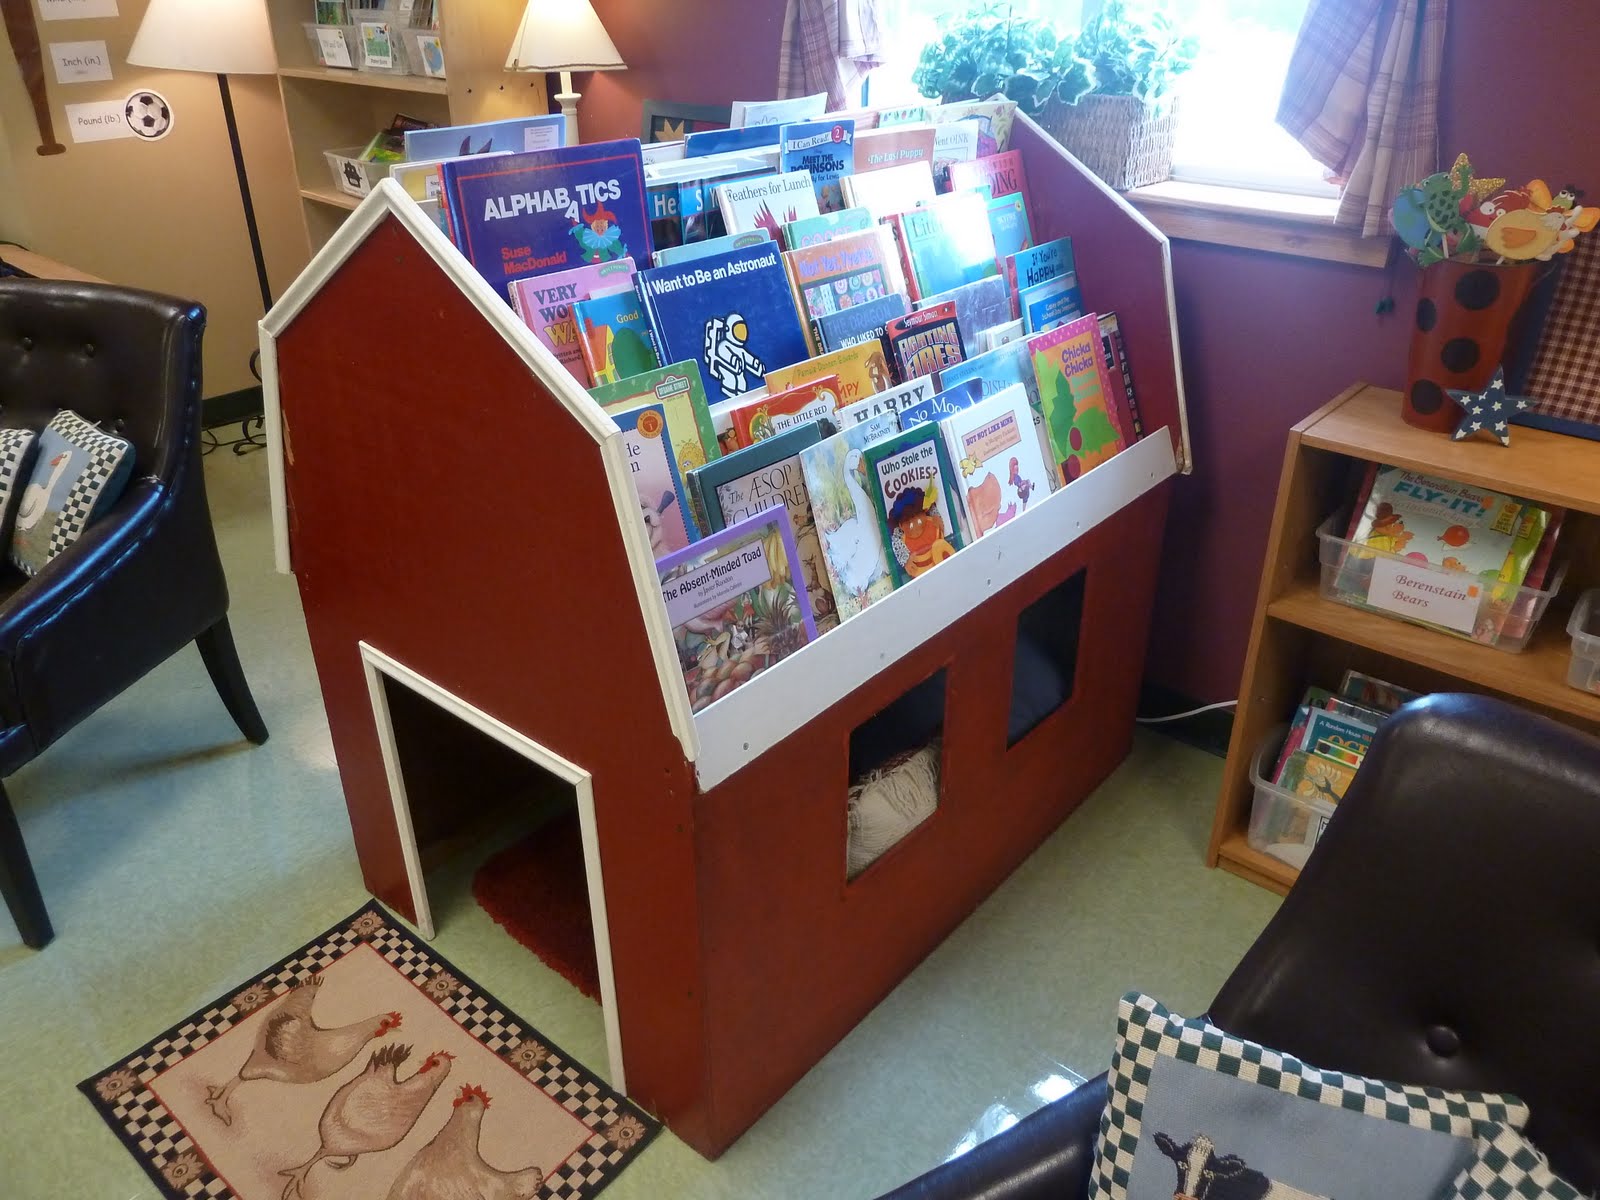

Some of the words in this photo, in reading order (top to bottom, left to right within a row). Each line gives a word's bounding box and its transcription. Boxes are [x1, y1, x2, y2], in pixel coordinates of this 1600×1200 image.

[62, 57, 82, 66] Inch
[78, 116, 102, 126] Pound
[797, 140, 811, 149] Can
[900, 148, 924, 161] Puppy
[802, 155, 821, 165] MEET
[821, 154, 834, 163] THE
[724, 184, 768, 203] Feathers
[768, 182, 782, 194] for
[783, 175, 812, 192] Lunch
[653, 196, 680, 217] He
[501, 245, 532, 261] Suse
[503, 251, 568, 276] MacDonald
[652, 275, 684, 295] Want
[684, 274, 696, 287] to
[695, 270, 712, 284] Be
[713, 267, 728, 280] an
[728, 252, 777, 277] Astronaut
[1026, 263, 1056, 287] Happy
[533, 282, 578, 305] VERY
[616, 310, 639, 324] Good
[904, 313, 923, 328] Seymour
[840, 335, 857, 348] WHO
[857, 330, 875, 344] LIKED
[875, 327, 884, 337] TO
[897, 321, 960, 364] FIGHTING
[904, 345, 963, 380] FIRES
[1061, 341, 1092, 363] Chicka
[1064, 356, 1094, 378] Chicka
[777, 417, 791, 431] THE
[792, 410, 814, 427] LITTLE
[814, 405, 828, 418] RED
[909, 410, 929, 426] No
[965, 435, 977, 446] BUT
[977, 430, 988, 441] NOT
[988, 423, 1000, 436] LIKE
[1000, 415, 1014, 428] MINE
[881, 462, 900, 476] Who
[901, 452, 920, 467] Stole
[920, 446, 934, 459] the
[728, 490, 744, 504] The
[661, 588, 679, 603] The
[679, 555, 742, 595] Absent-Minded
[741, 546, 762, 563] Toad
[1395, 574, 1467, 601] Berenstain
[1392, 590, 1429, 608] Bears
[1326, 722, 1345, 734] Random
